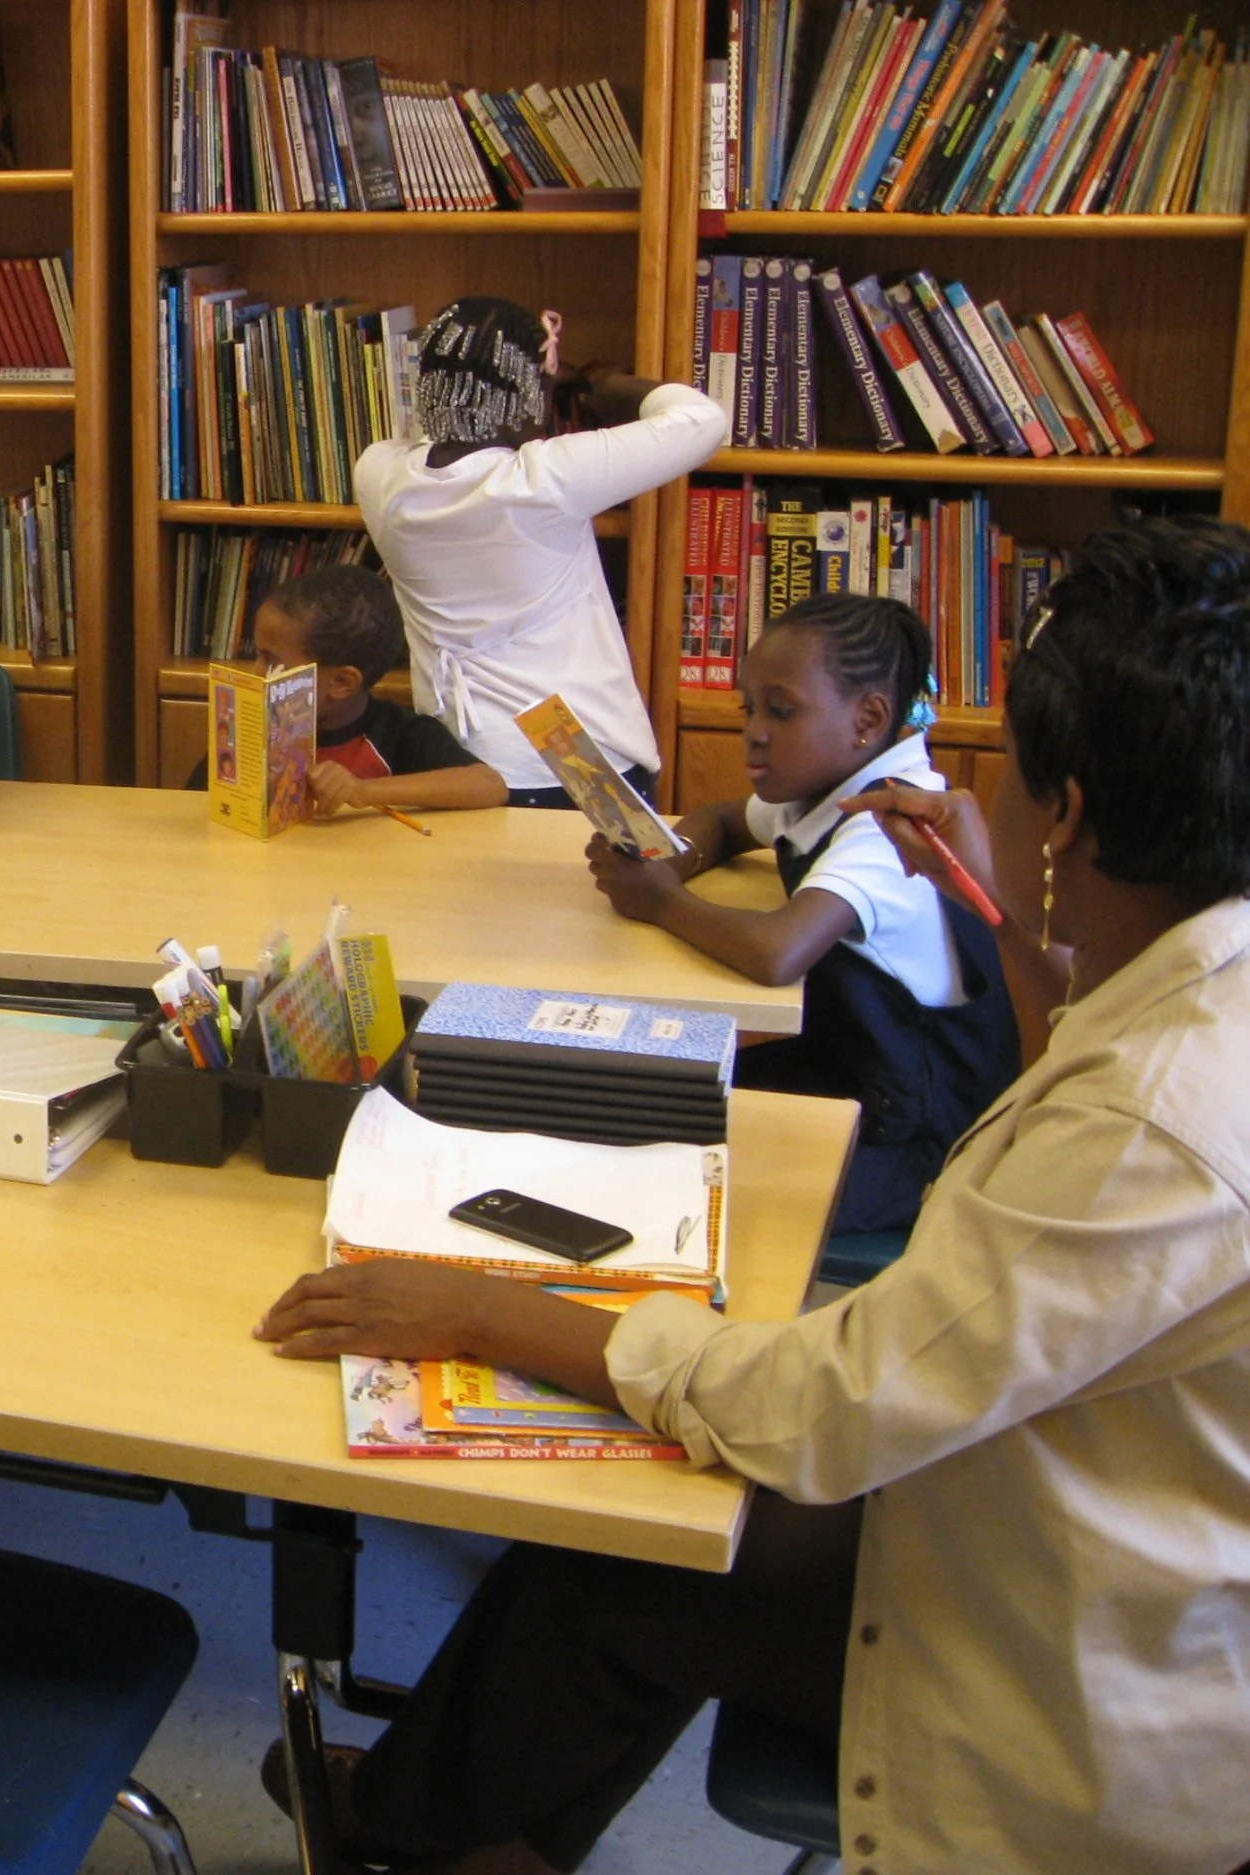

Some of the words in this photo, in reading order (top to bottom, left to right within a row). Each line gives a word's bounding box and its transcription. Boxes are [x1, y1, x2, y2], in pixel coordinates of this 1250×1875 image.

[711, 94, 725, 207] SCIENCE
[693, 285, 709, 361] Elementary
[741, 287, 758, 364] Elementary
[763, 287, 781, 364] Elementary
[795, 290, 810, 366] Elementary
[737, 366, 754, 439] Dictionary
[760, 366, 778, 439] Dictionary
[833, 296, 868, 370] Elementary
[861, 371, 895, 441] Dictionary
[907, 308, 951, 378] Elementary
[946, 375, 990, 443] Dictionary
[983, 343, 1018, 405] Dictionary
[794, 370, 811, 442] Dictionary
[776, 516, 808, 524] SECOND
[776, 525, 808, 533] EDITION
[781, 500, 803, 512] THE
[790, 539, 812, 606] CAMB
[341, 940, 357, 991] REWARD
[350, 994, 369, 1051] STICKERS
[458, 1446, 504, 1459] CHIMPS
[509, 1446, 552, 1459] DON'T
[556, 1446, 597, 1459] WEAR
[601, 1446, 652, 1459] GLASSES
